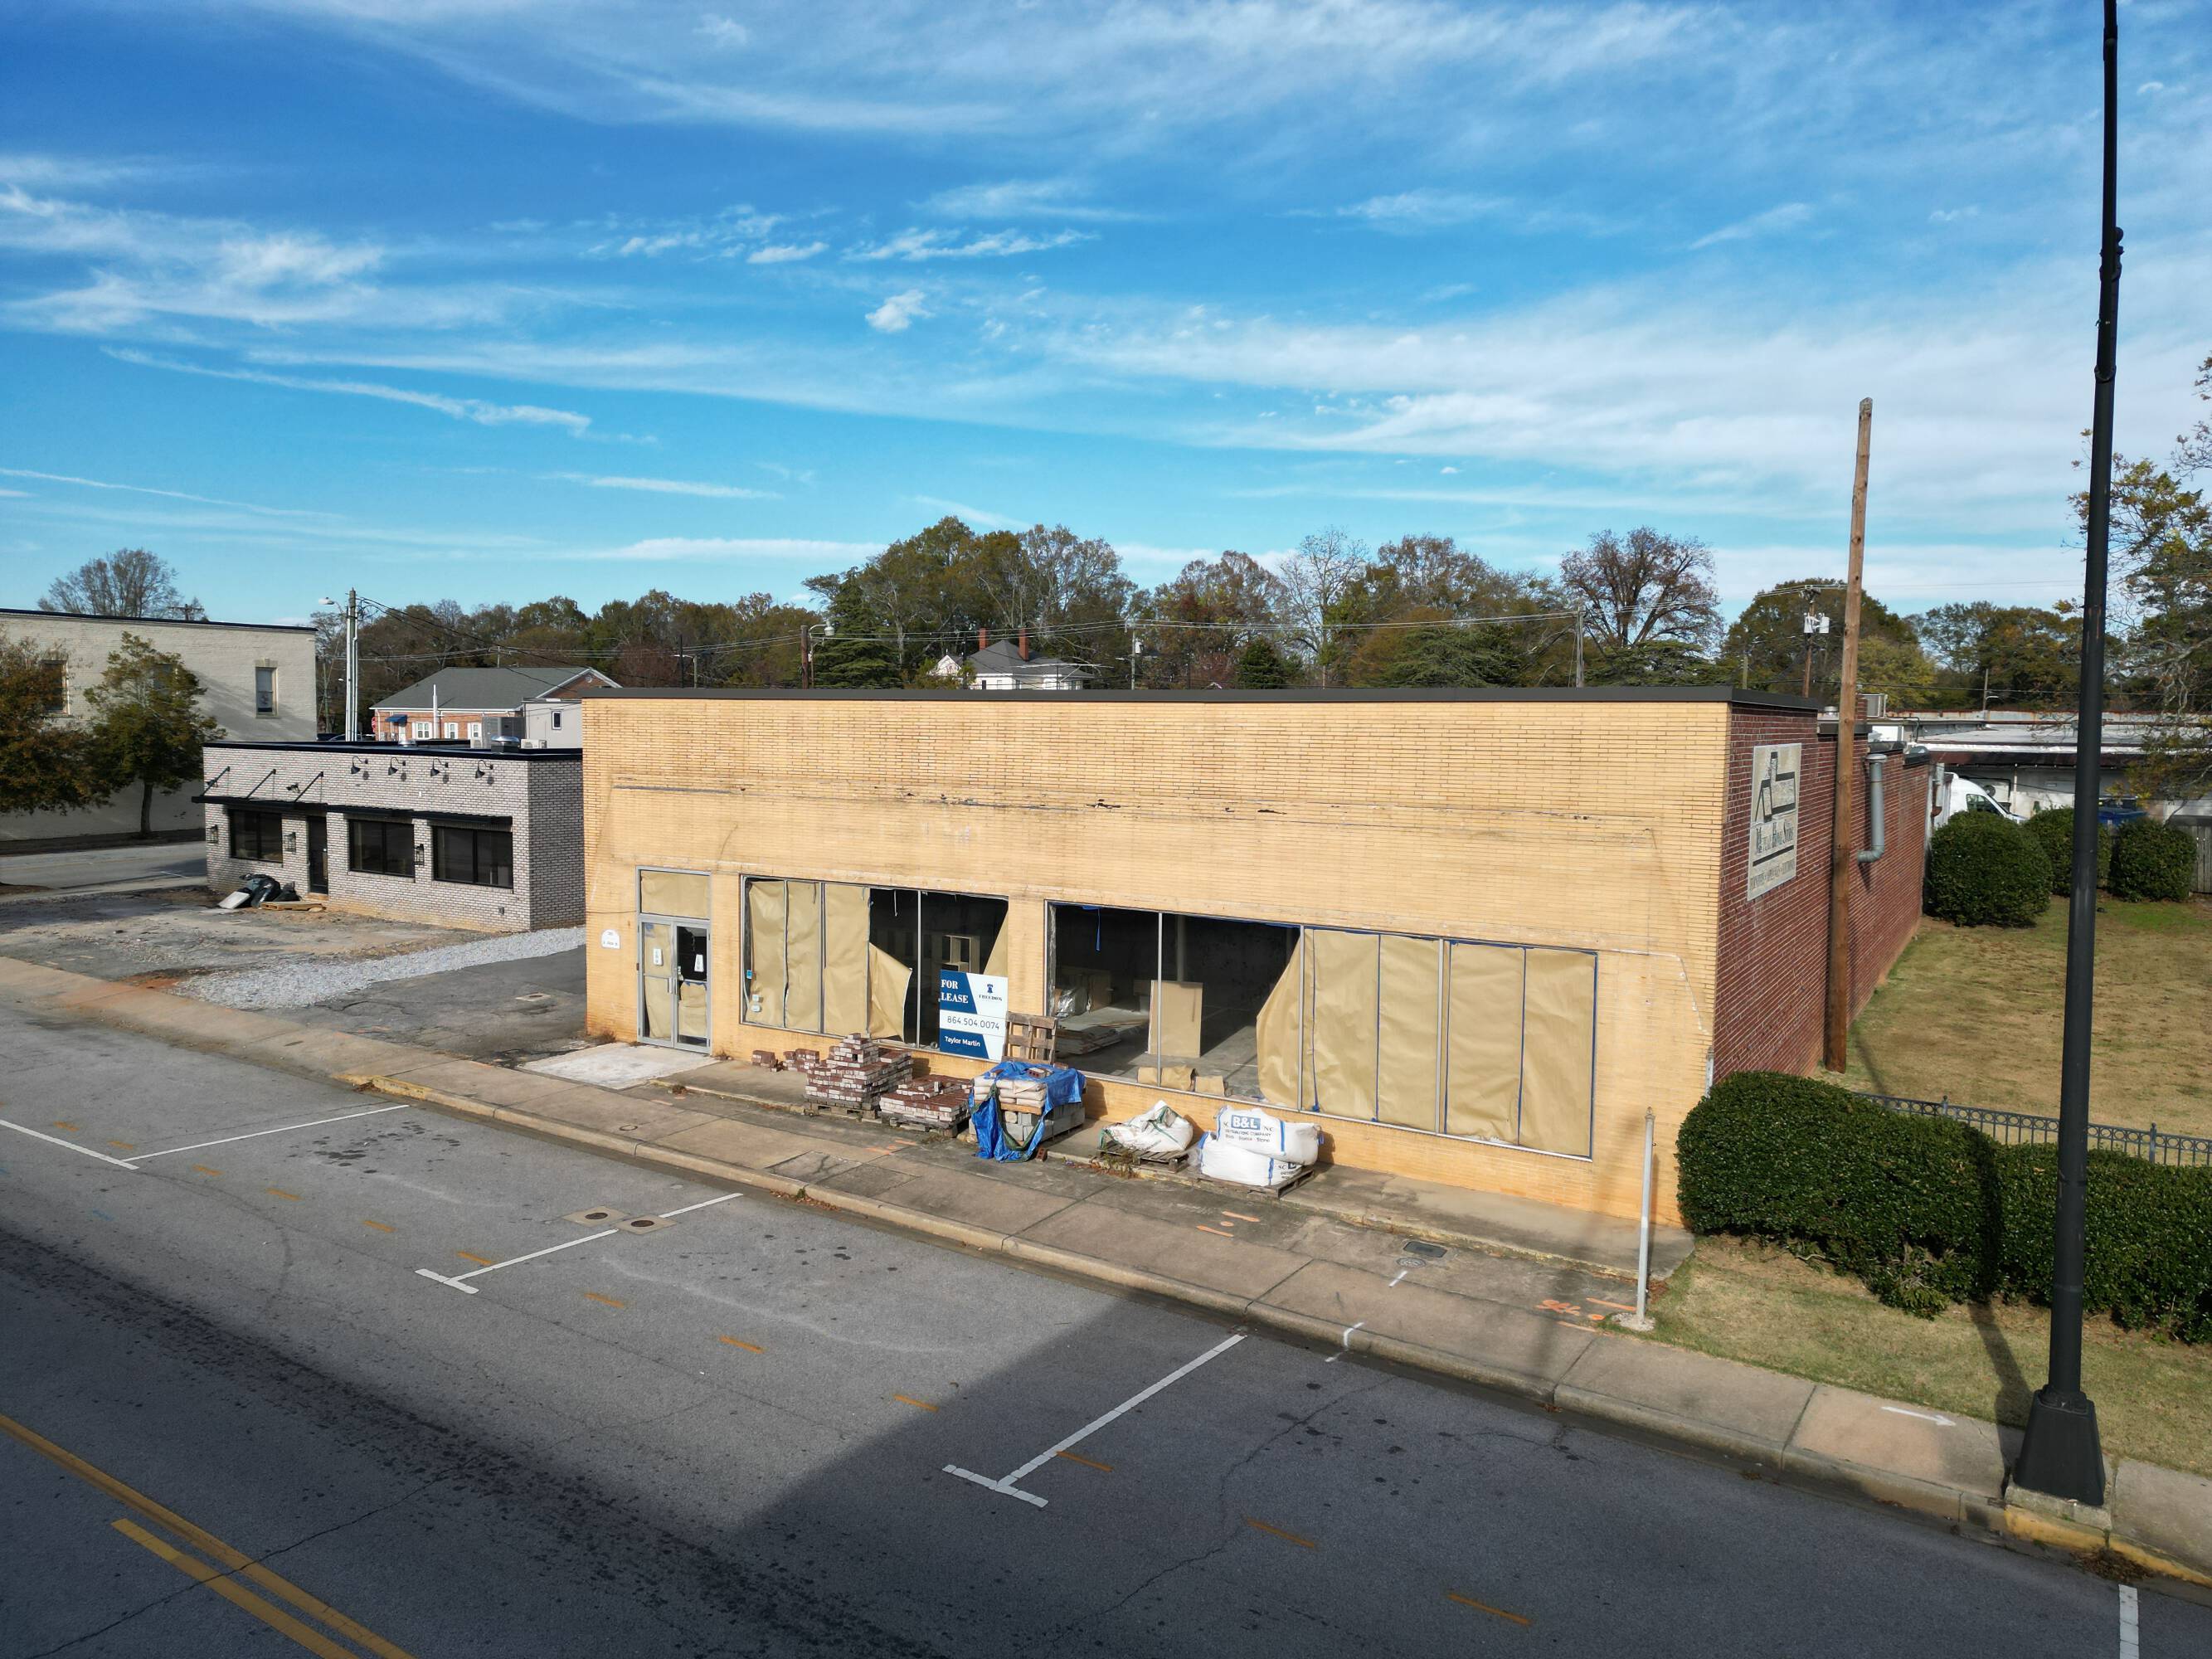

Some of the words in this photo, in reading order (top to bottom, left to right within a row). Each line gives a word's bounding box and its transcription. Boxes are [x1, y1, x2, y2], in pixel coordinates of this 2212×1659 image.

[941, 979, 958, 990] FOR
[941, 992, 969, 1004] LEASE
[947, 1015, 999, 1030] 864.504.0074
[945, 1036, 961, 1044] Taylor
[962, 1038, 980, 1047] Martin
[1232, 1117, 1258, 1129] B&L
